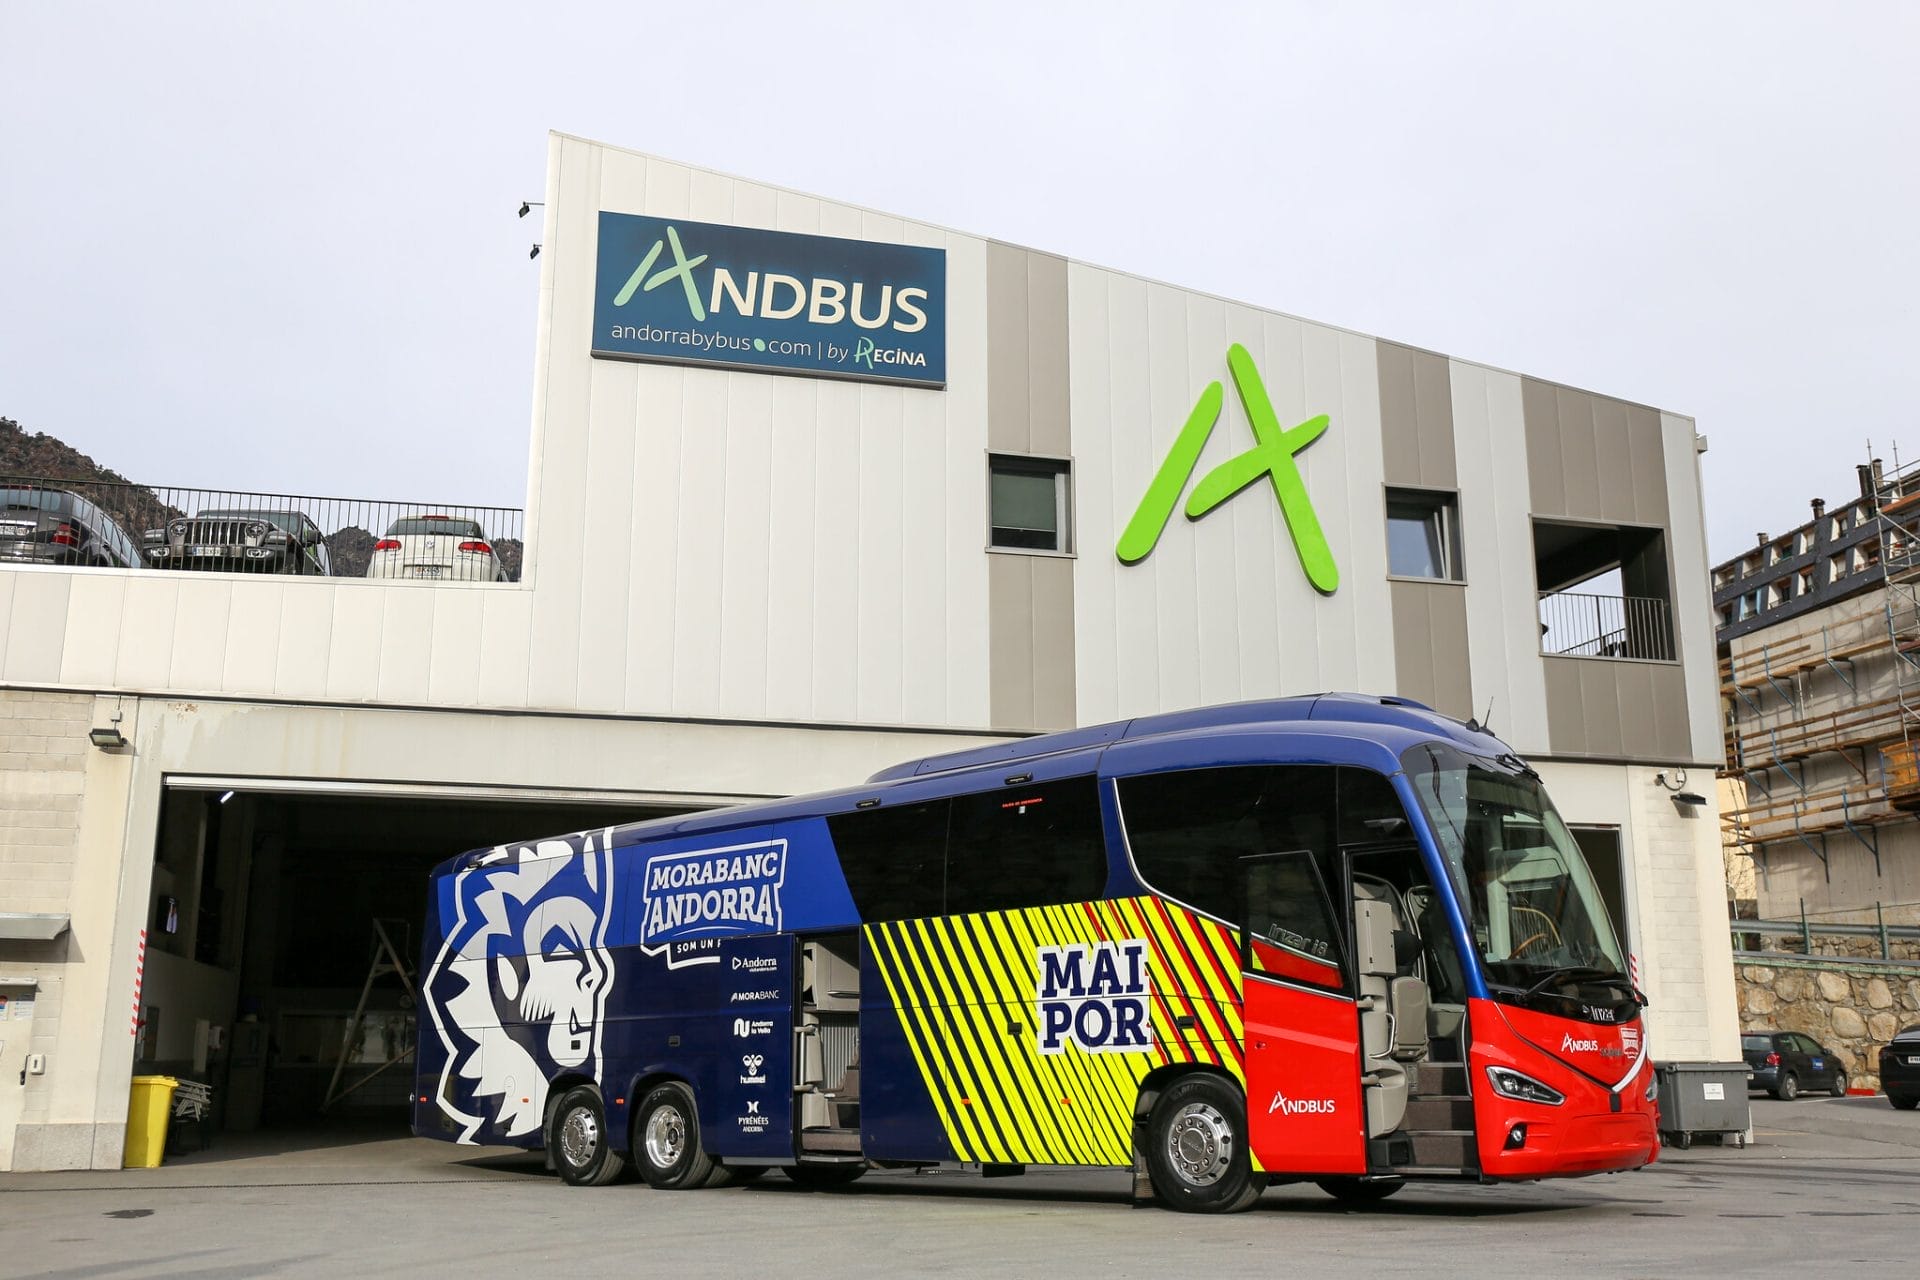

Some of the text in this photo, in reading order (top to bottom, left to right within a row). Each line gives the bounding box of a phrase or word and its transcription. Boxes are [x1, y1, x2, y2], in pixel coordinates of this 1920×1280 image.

[613, 225, 928, 333] ANDBUS
[828, 342, 849, 363] by
[650, 852, 778, 890] MORABANC
[647, 884, 774, 938] ANDORRA
[677, 941, 697, 954] SOM
[700, 938, 714, 950] UN
[742, 957, 777, 969] Andorra
[1041, 945, 1144, 998] MAI
[1042, 998, 1148, 1049] POR
[1561, 1032, 1599, 1054] ANDBUS
[740, 1075, 766, 1084] hummel
[1268, 1091, 1335, 1116] ANDBUS
